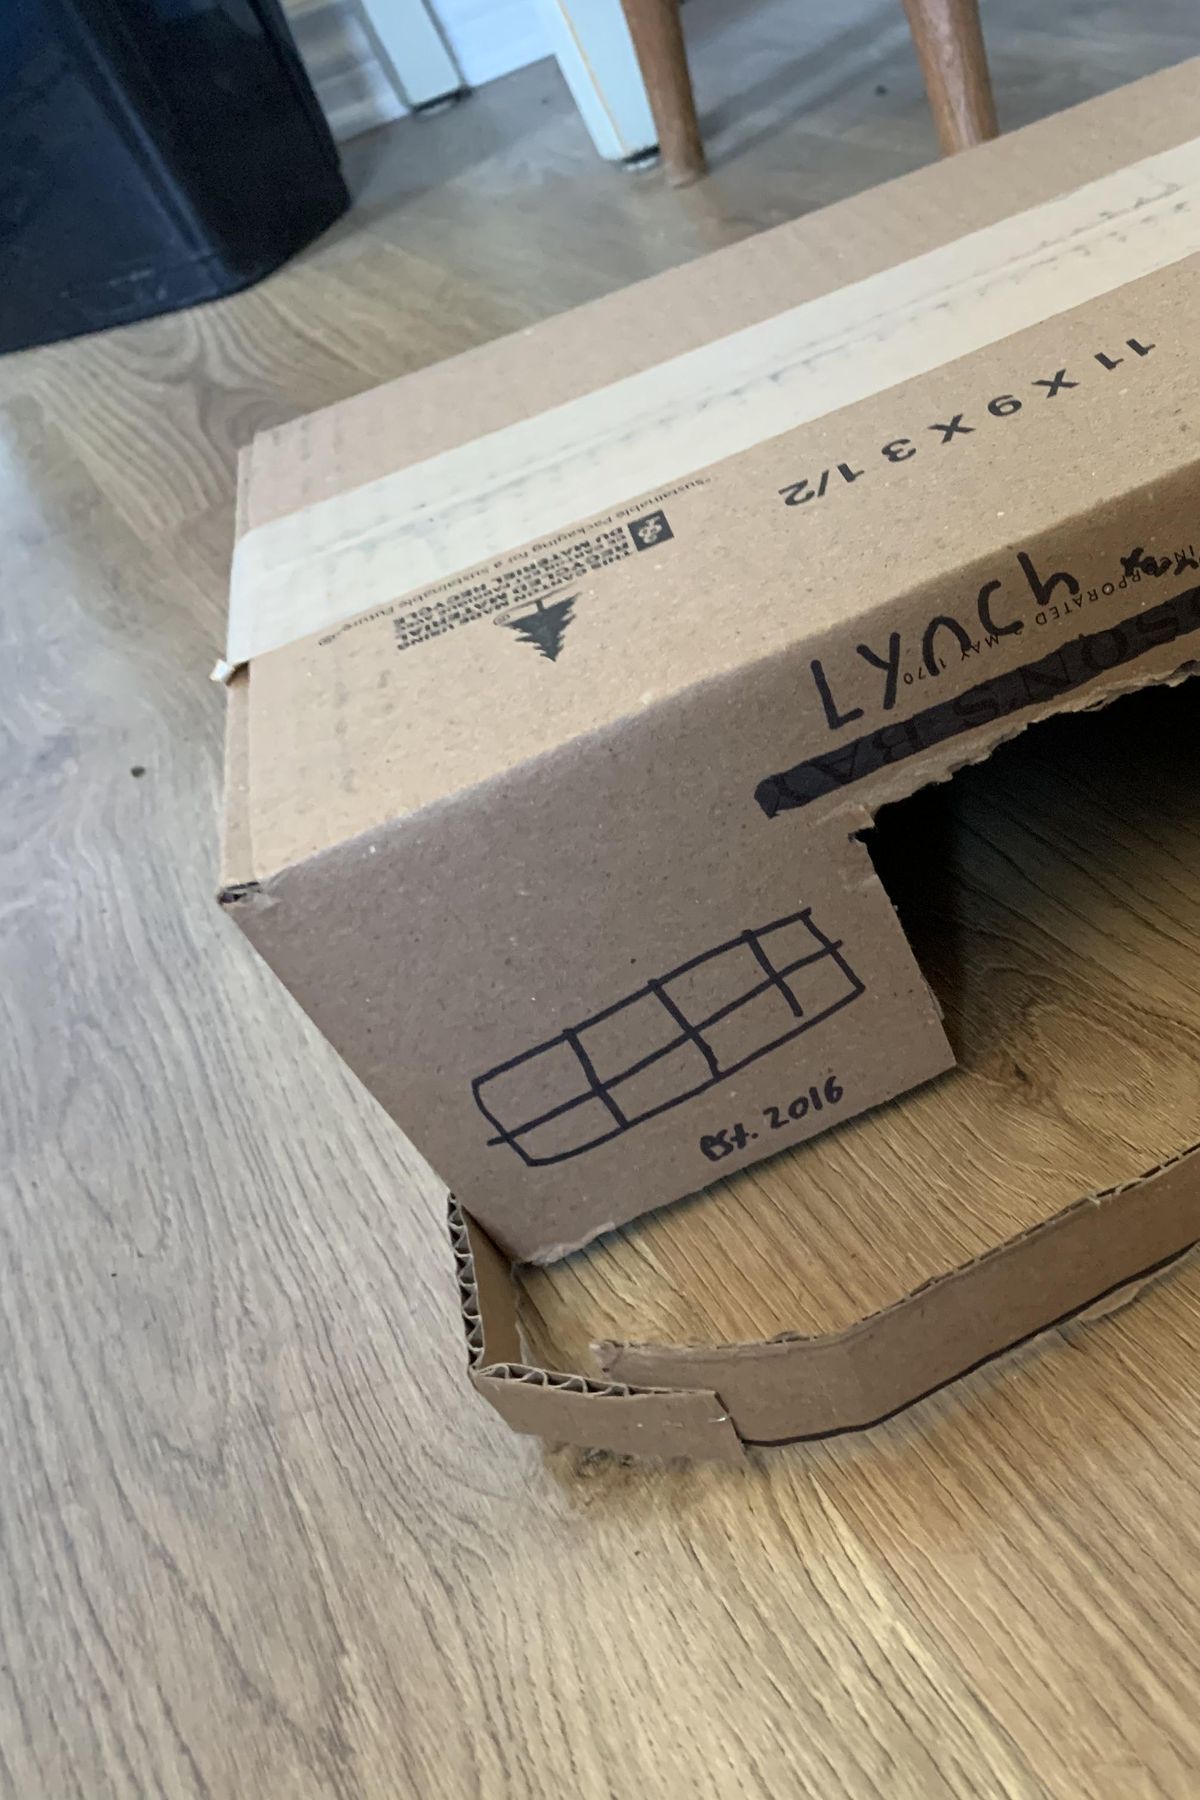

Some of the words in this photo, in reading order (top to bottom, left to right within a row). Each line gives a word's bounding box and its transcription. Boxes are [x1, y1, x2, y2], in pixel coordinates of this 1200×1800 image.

[1094, 338, 1156, 371] 11
[986, 394, 1023, 418] 9
[881, 438, 917, 463] 3
[778, 463, 865, 507] 1/2
[902, 657, 947, 685] 170
[762, 1075, 844, 1130] 2016
